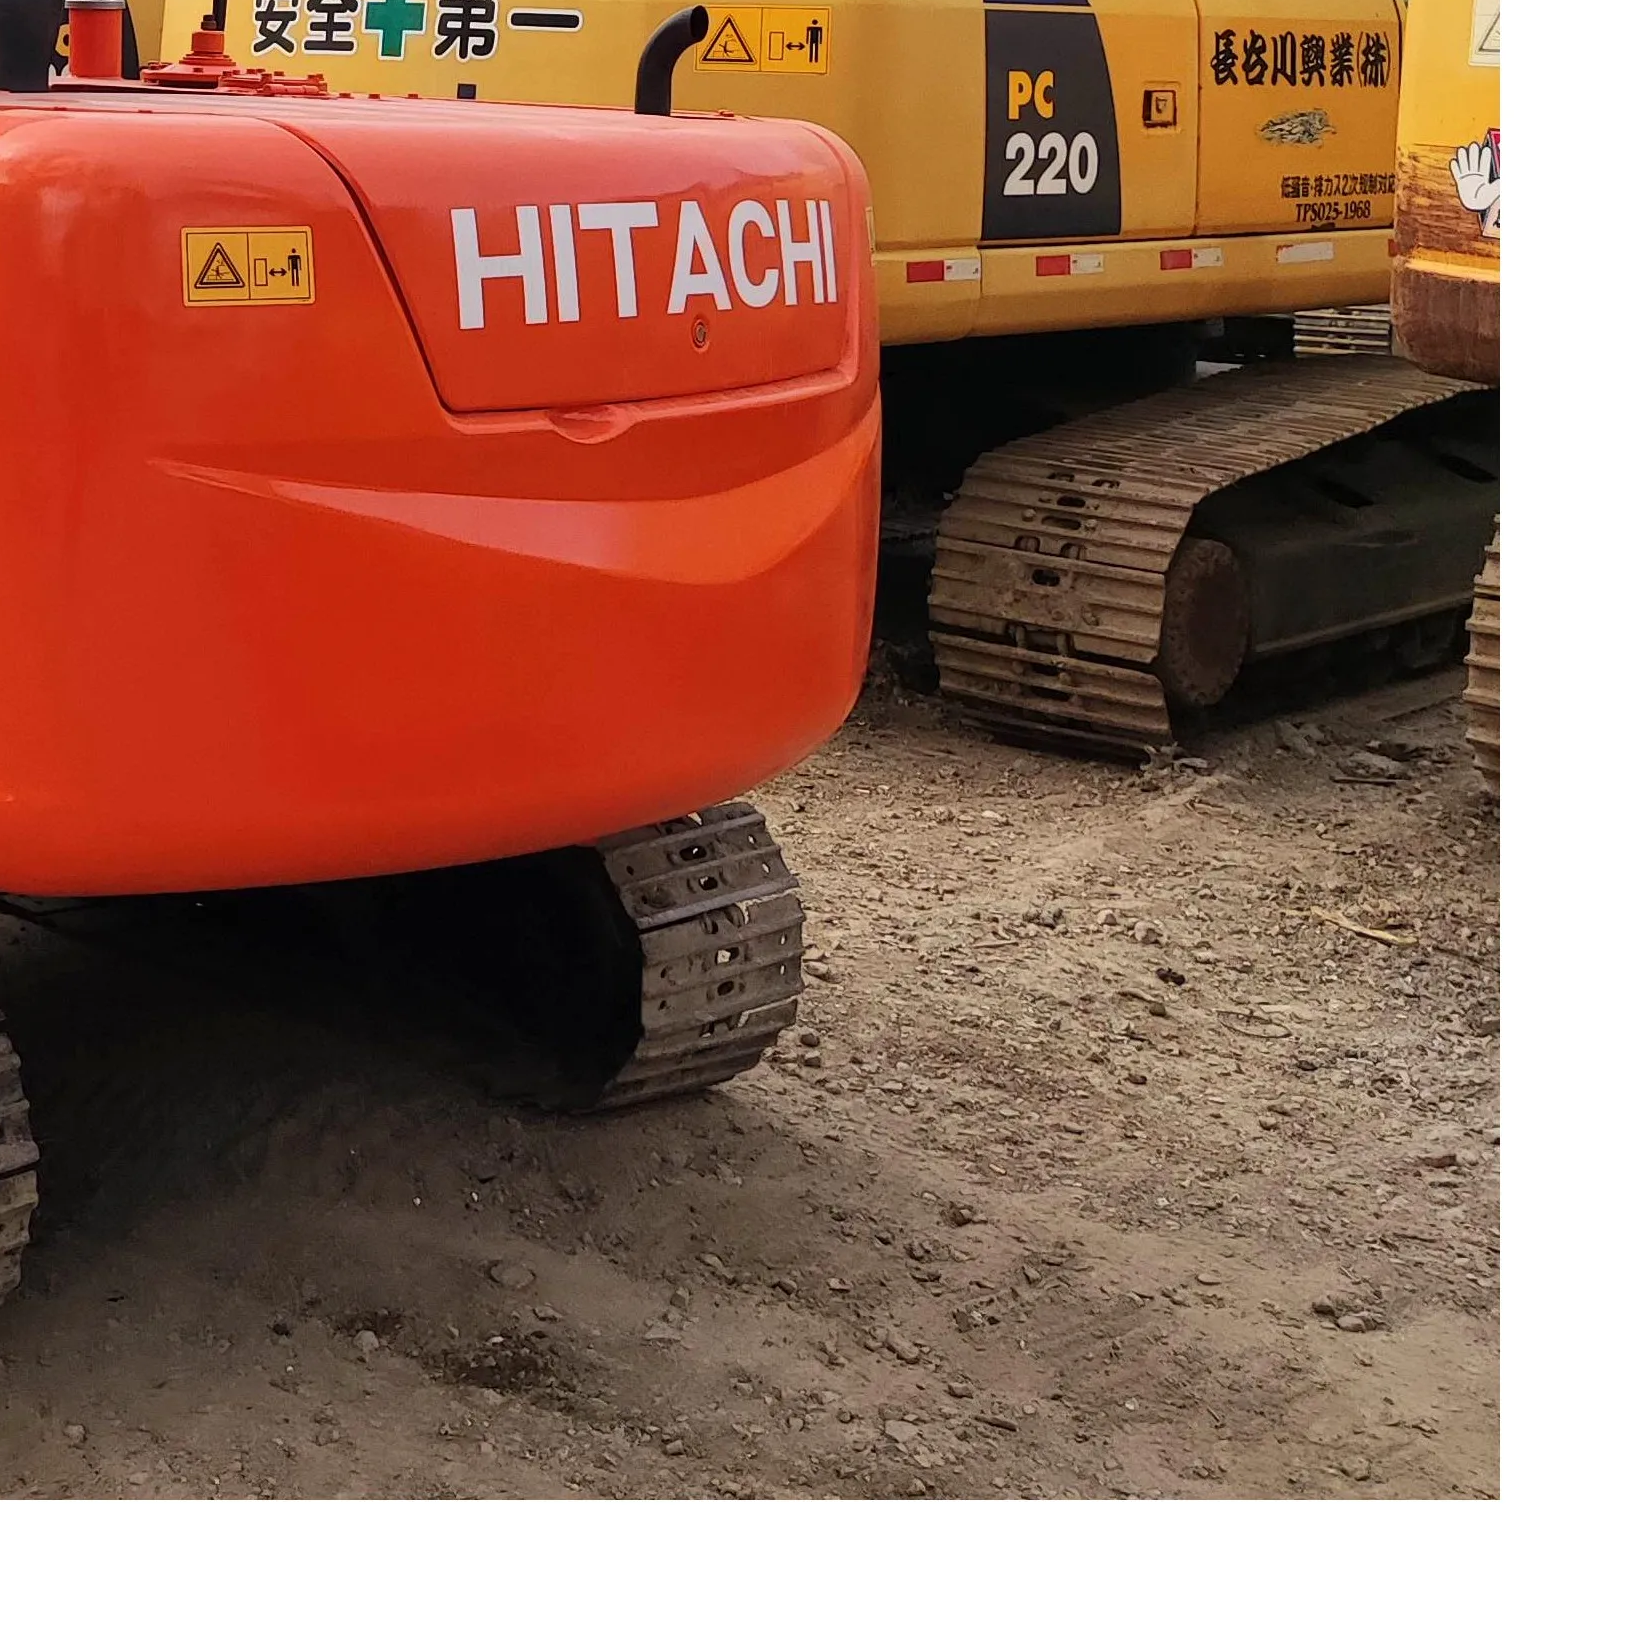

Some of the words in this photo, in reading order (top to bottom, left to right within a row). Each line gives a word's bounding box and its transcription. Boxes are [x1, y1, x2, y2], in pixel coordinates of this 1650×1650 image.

[1008, 70, 1054, 119] PC
[1003, 131, 1099, 196] 220
[450, 198, 838, 331] HITACHI
